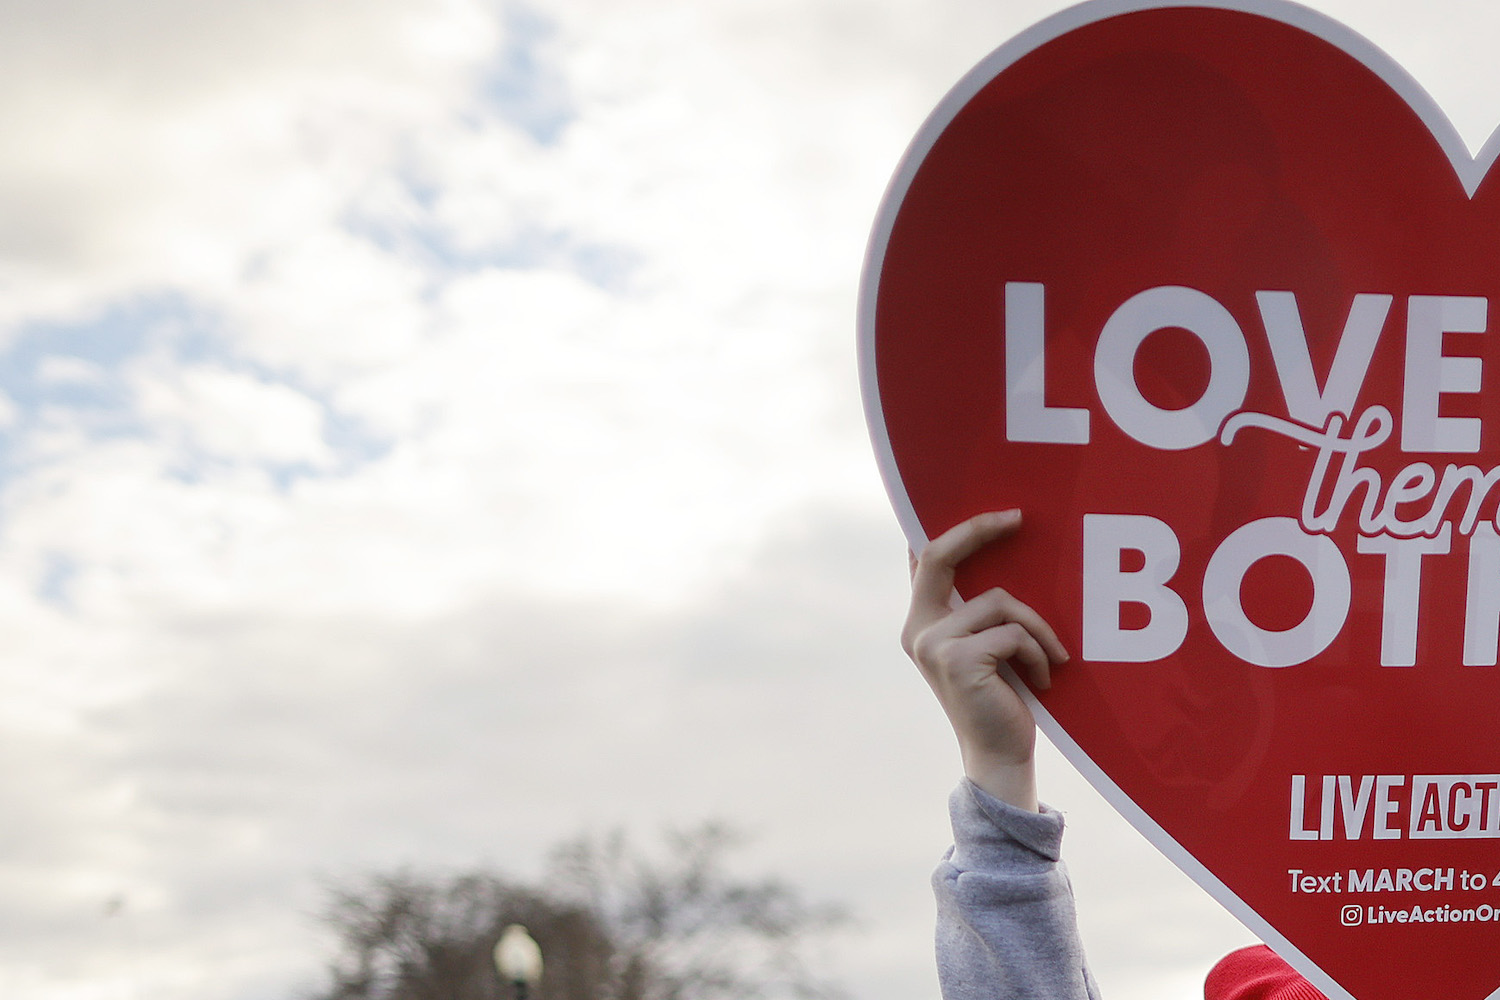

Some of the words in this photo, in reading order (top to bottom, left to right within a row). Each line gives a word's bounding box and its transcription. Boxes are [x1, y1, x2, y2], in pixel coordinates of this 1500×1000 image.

[1005, 281, 1488, 453] LOVE
[1289, 774, 1405, 840] LIVE
[1288, 868, 1342, 894] Text
[1348, 866, 1454, 893] MARCH
[1460, 868, 1487, 892] to
